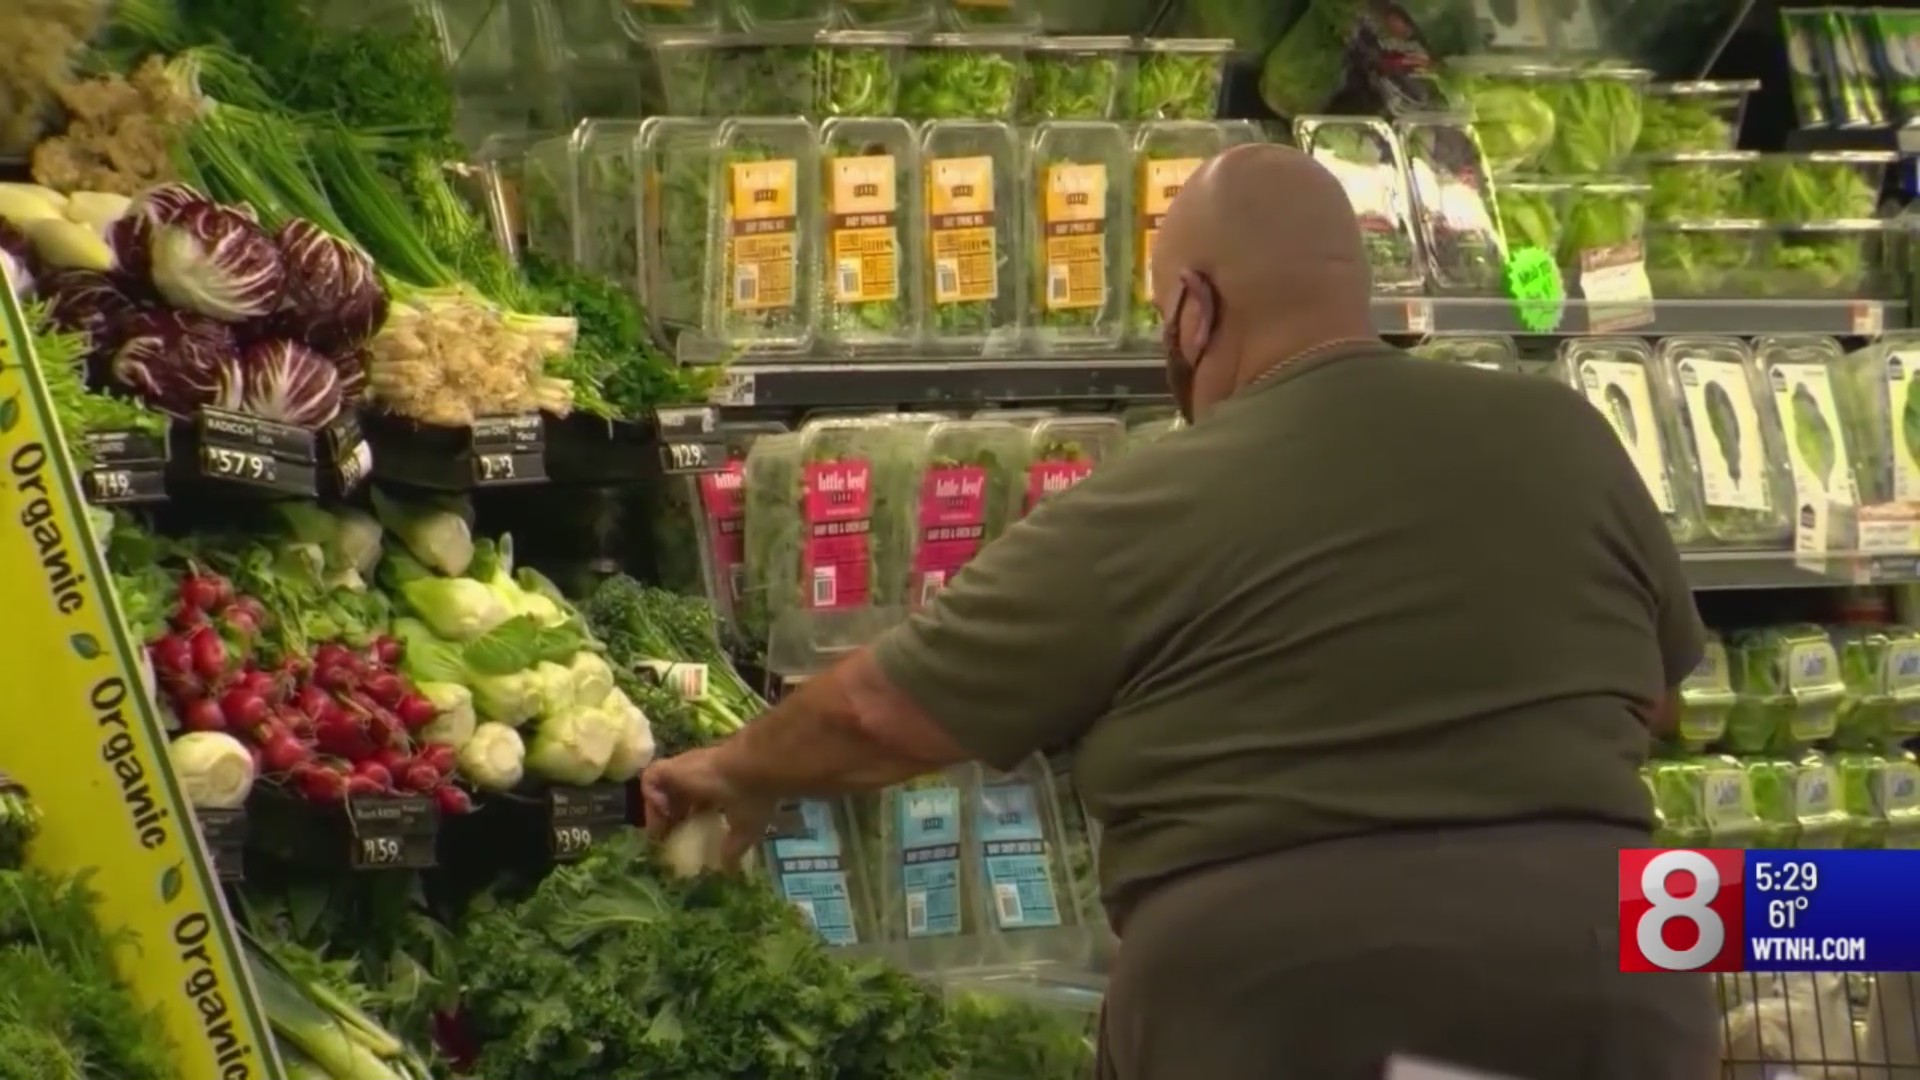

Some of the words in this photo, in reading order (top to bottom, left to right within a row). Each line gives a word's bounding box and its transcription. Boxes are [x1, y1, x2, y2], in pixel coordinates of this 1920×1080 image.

[818, 471, 845, 492] little
[847, 468, 868, 492] leaf
[936, 479, 959, 497] little
[961, 476, 984, 498] leaf
[1043, 471, 1069, 491] little
[10, 441, 86, 616] Organic
[90, 677, 169, 850] Organic
[174, 912, 252, 1080] Organic
